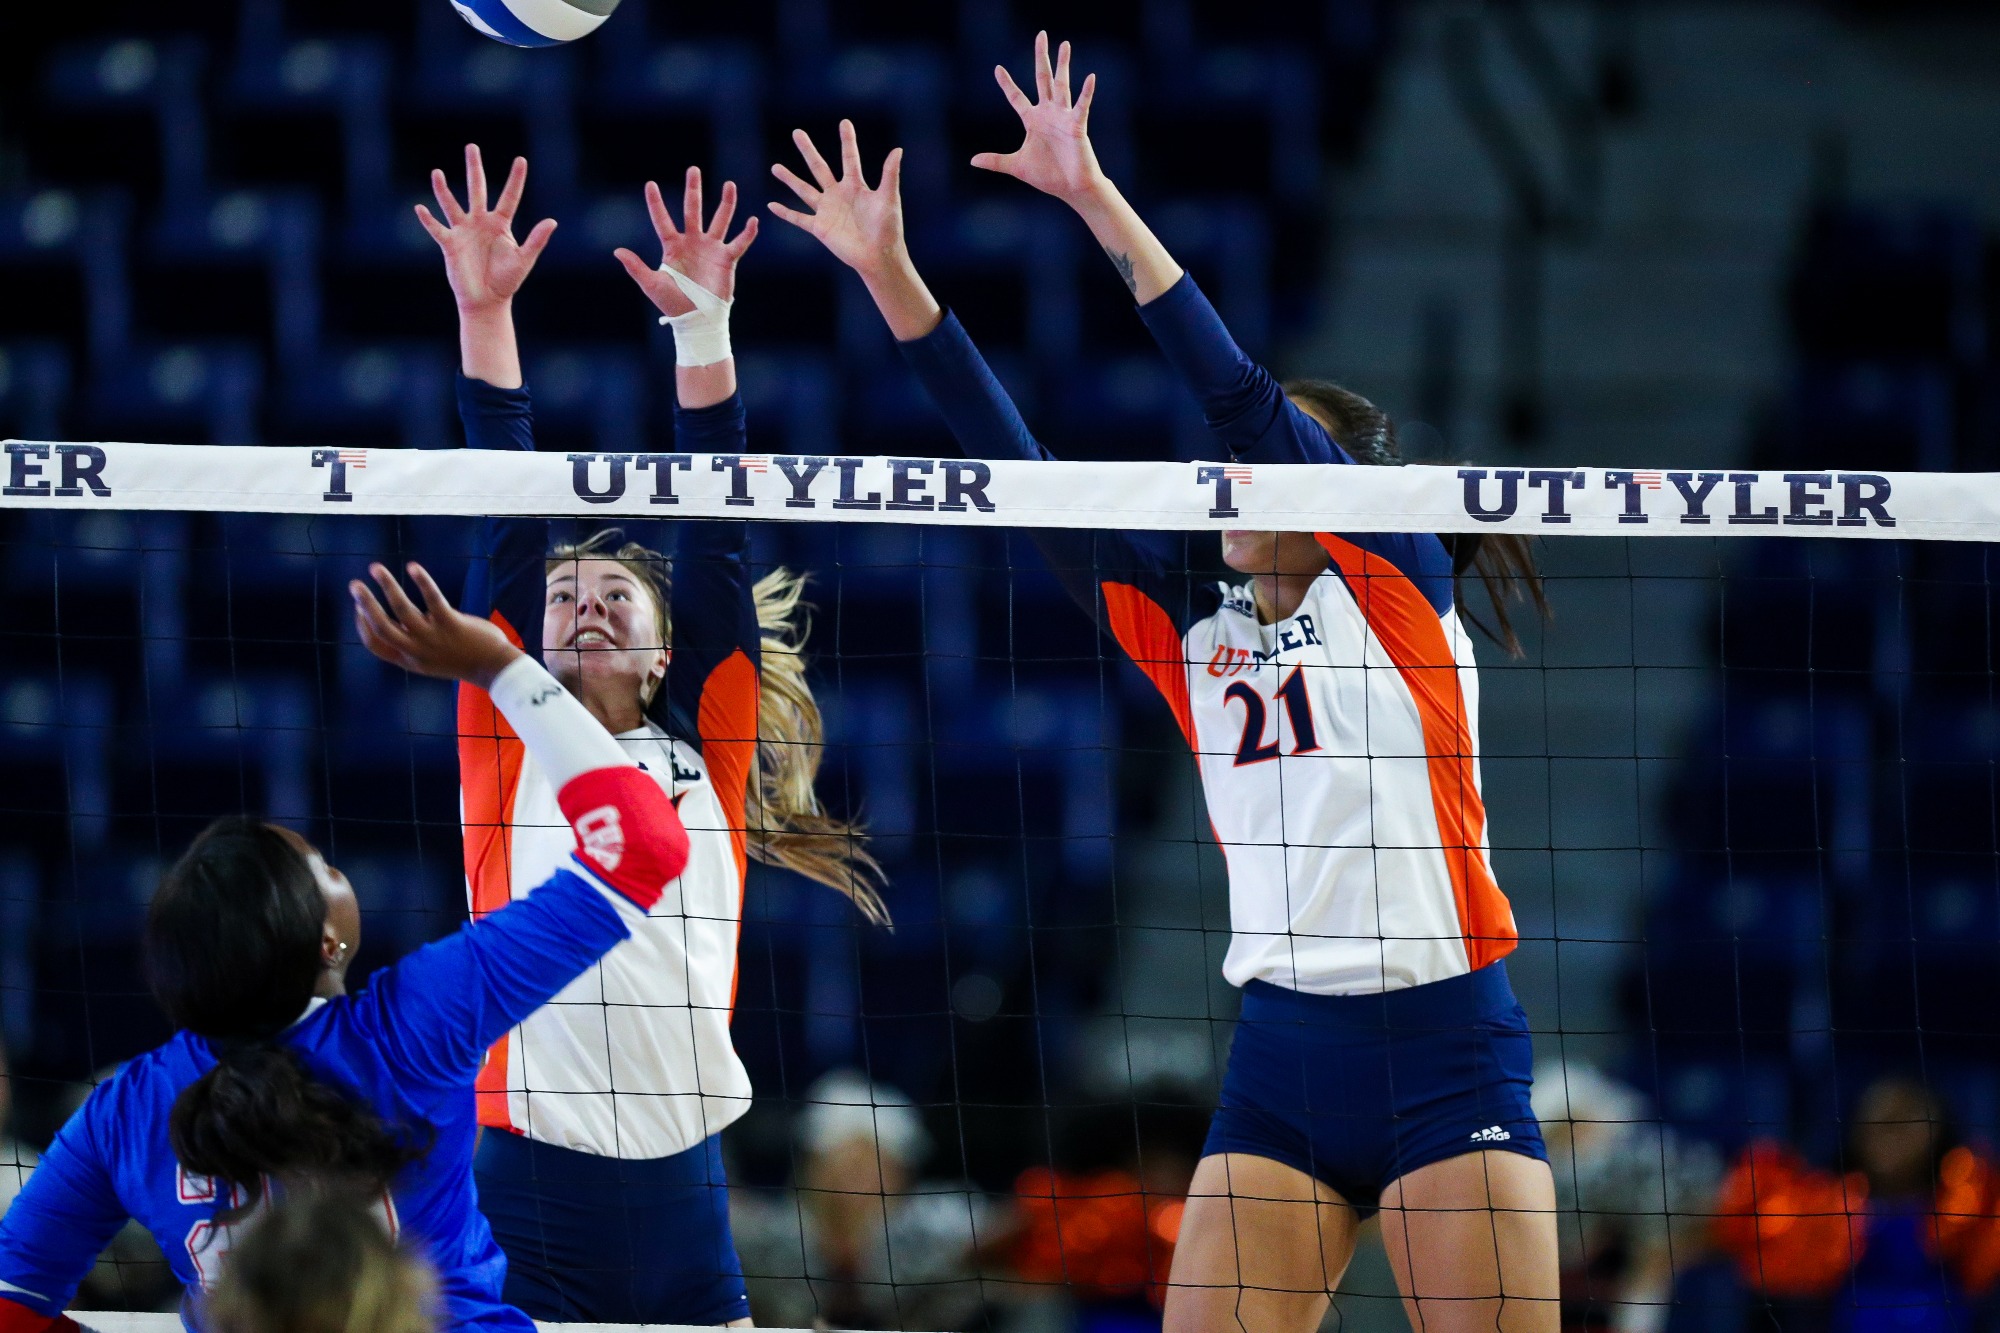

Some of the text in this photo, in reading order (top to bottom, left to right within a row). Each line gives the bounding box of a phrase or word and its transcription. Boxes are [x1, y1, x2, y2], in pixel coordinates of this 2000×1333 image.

[3, 444, 112, 497] ER
[312, 450, 367, 502] T
[567, 455, 996, 513] UT TYLER
[1197, 467, 1252, 518] T
[1458, 470, 1897, 527] UT TYLER
[1224, 660, 1324, 767] 21
